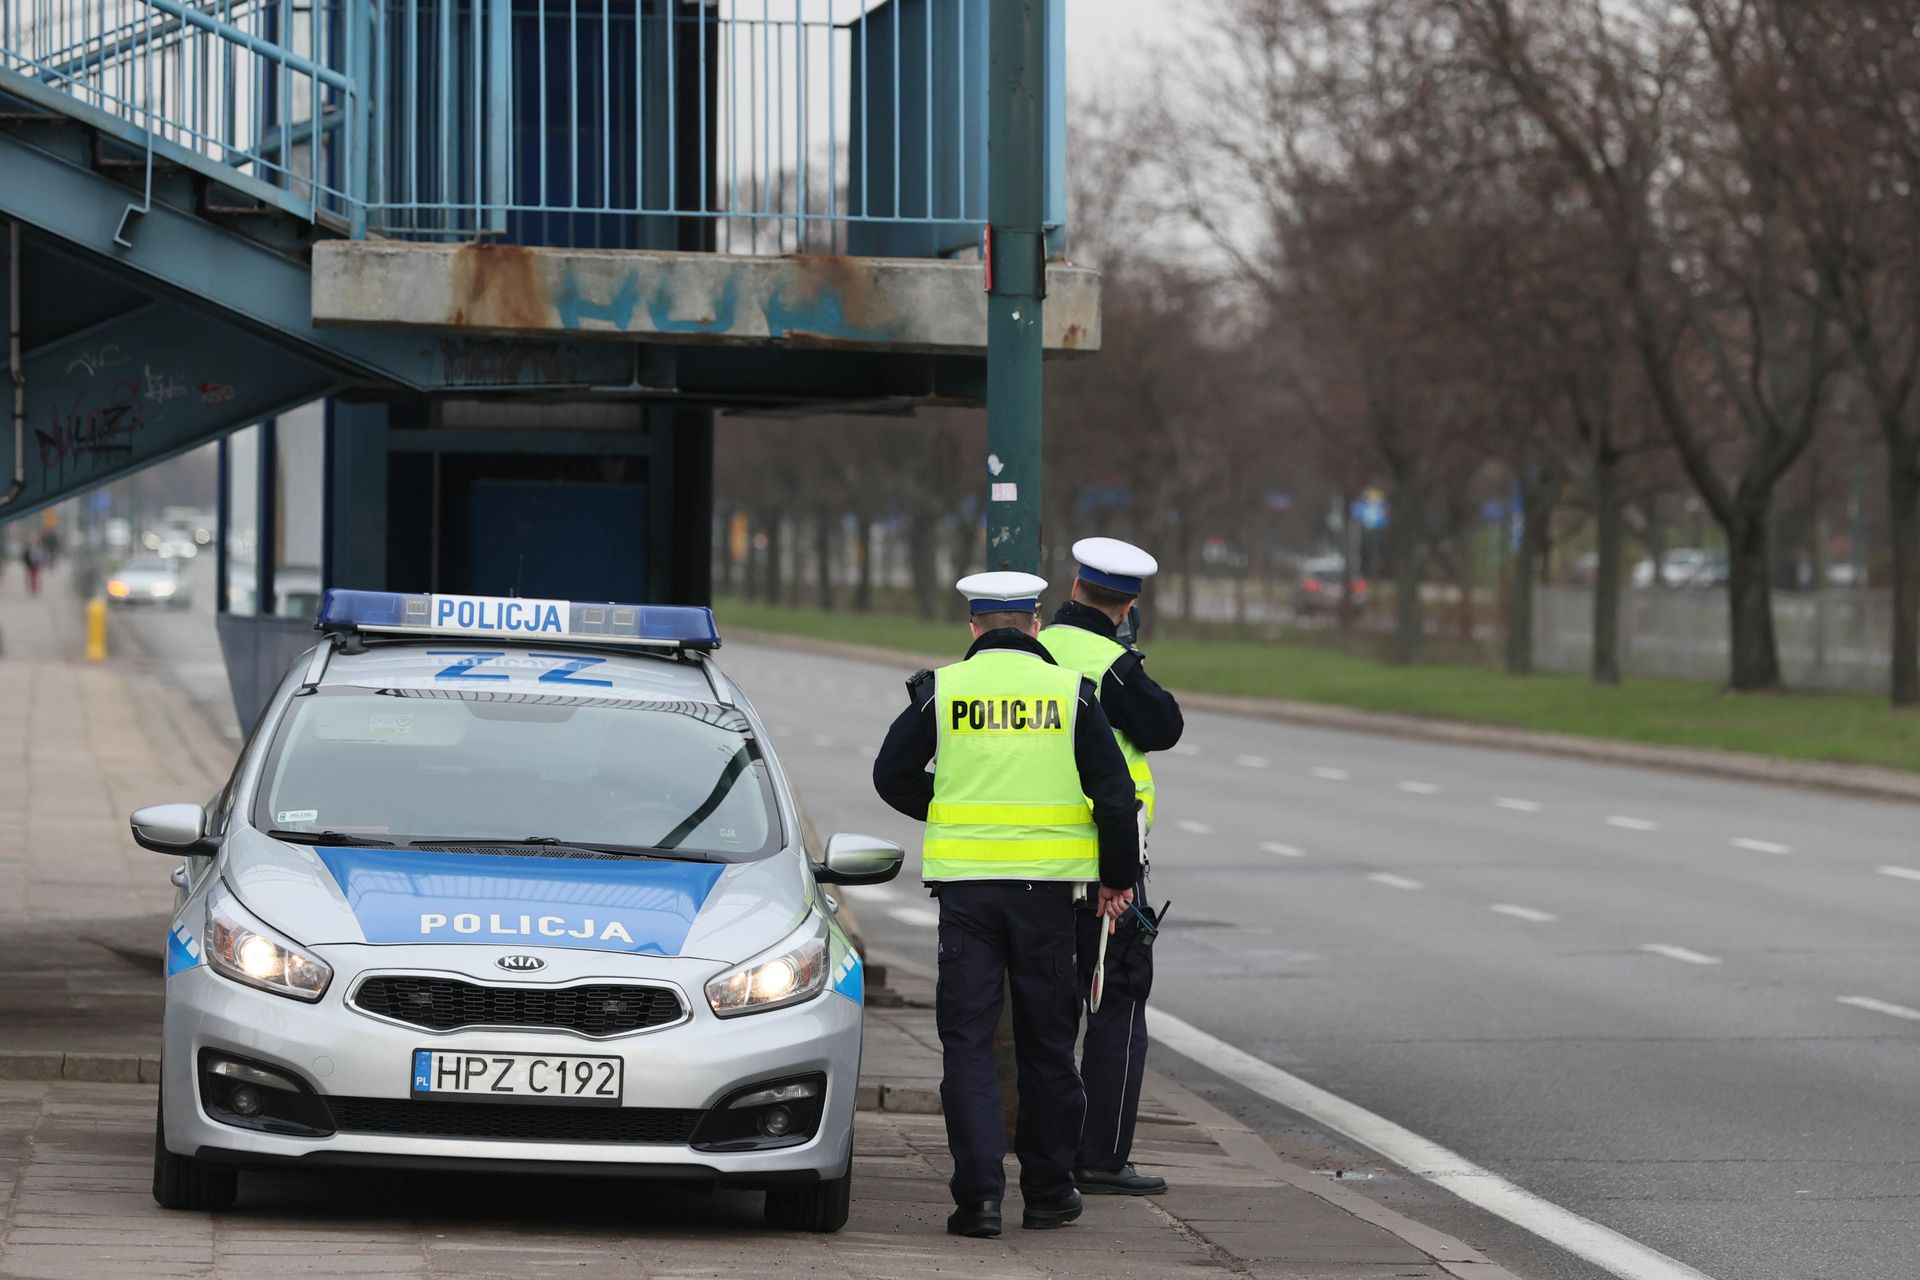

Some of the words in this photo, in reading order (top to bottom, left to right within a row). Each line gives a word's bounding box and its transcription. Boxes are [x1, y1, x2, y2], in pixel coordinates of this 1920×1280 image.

[437, 599, 563, 633] POLICJA
[952, 700, 1062, 730] POLICJA
[420, 913, 634, 944] POLICJA
[503, 956, 539, 968] KIA
[416, 1076, 429, 1087] PL
[437, 1055, 516, 1092] HPZ
[528, 1059, 615, 1096] C192
